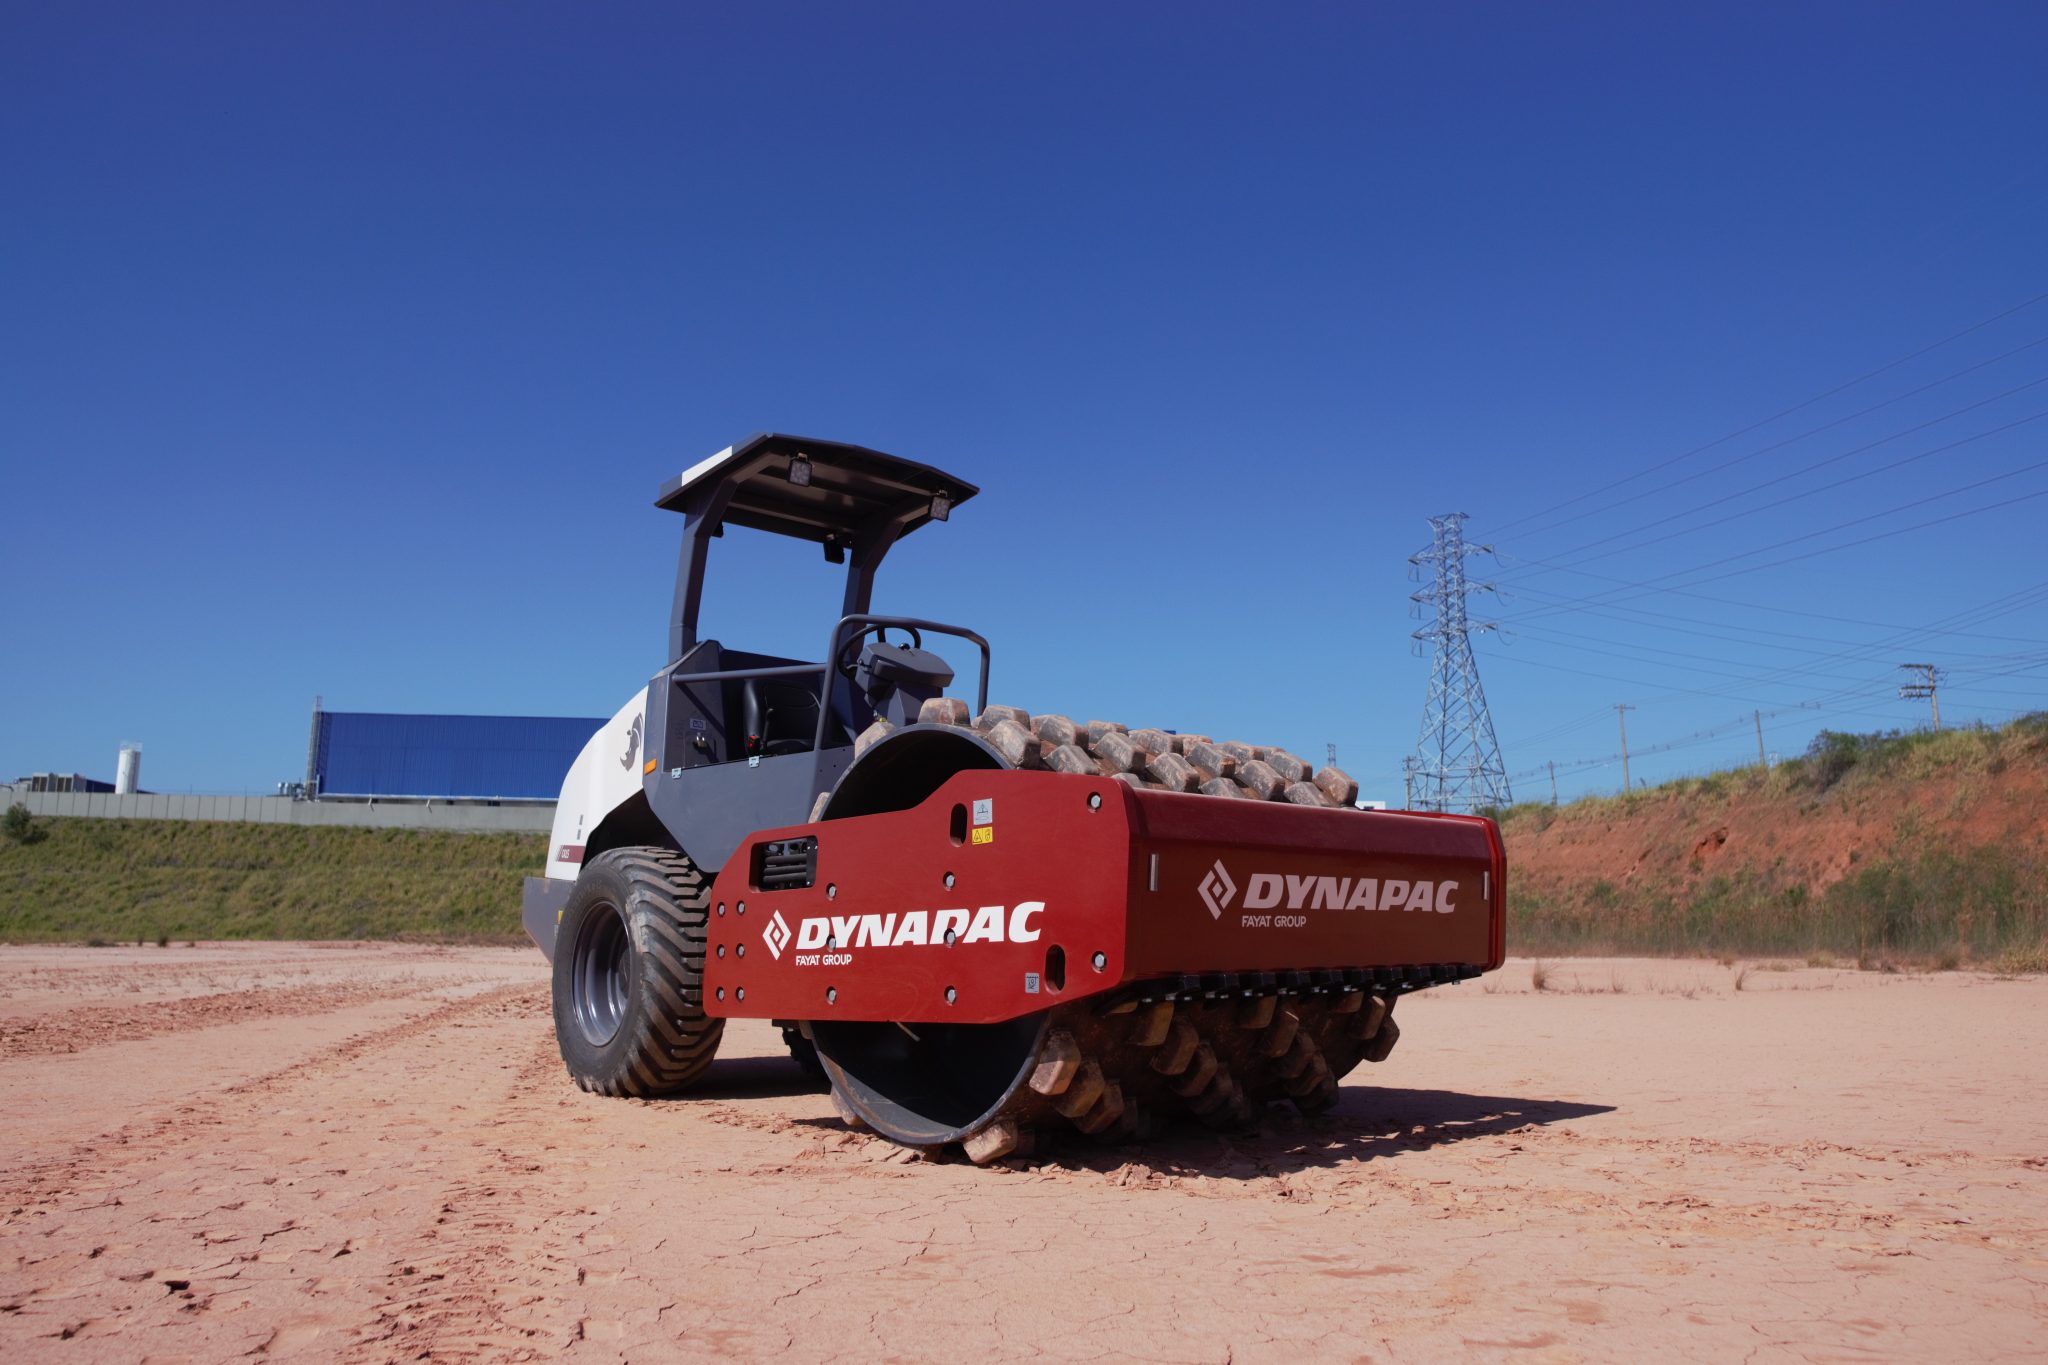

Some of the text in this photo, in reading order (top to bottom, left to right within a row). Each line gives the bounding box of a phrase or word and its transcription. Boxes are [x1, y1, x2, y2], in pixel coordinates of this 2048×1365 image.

[1242, 873, 1459, 914] DYNAPAC
[795, 901, 1046, 950] DYNAPAC
[1241, 915, 1307, 928] FAYAT GROUP
[795, 953, 853, 967] FAYAT GROUP
